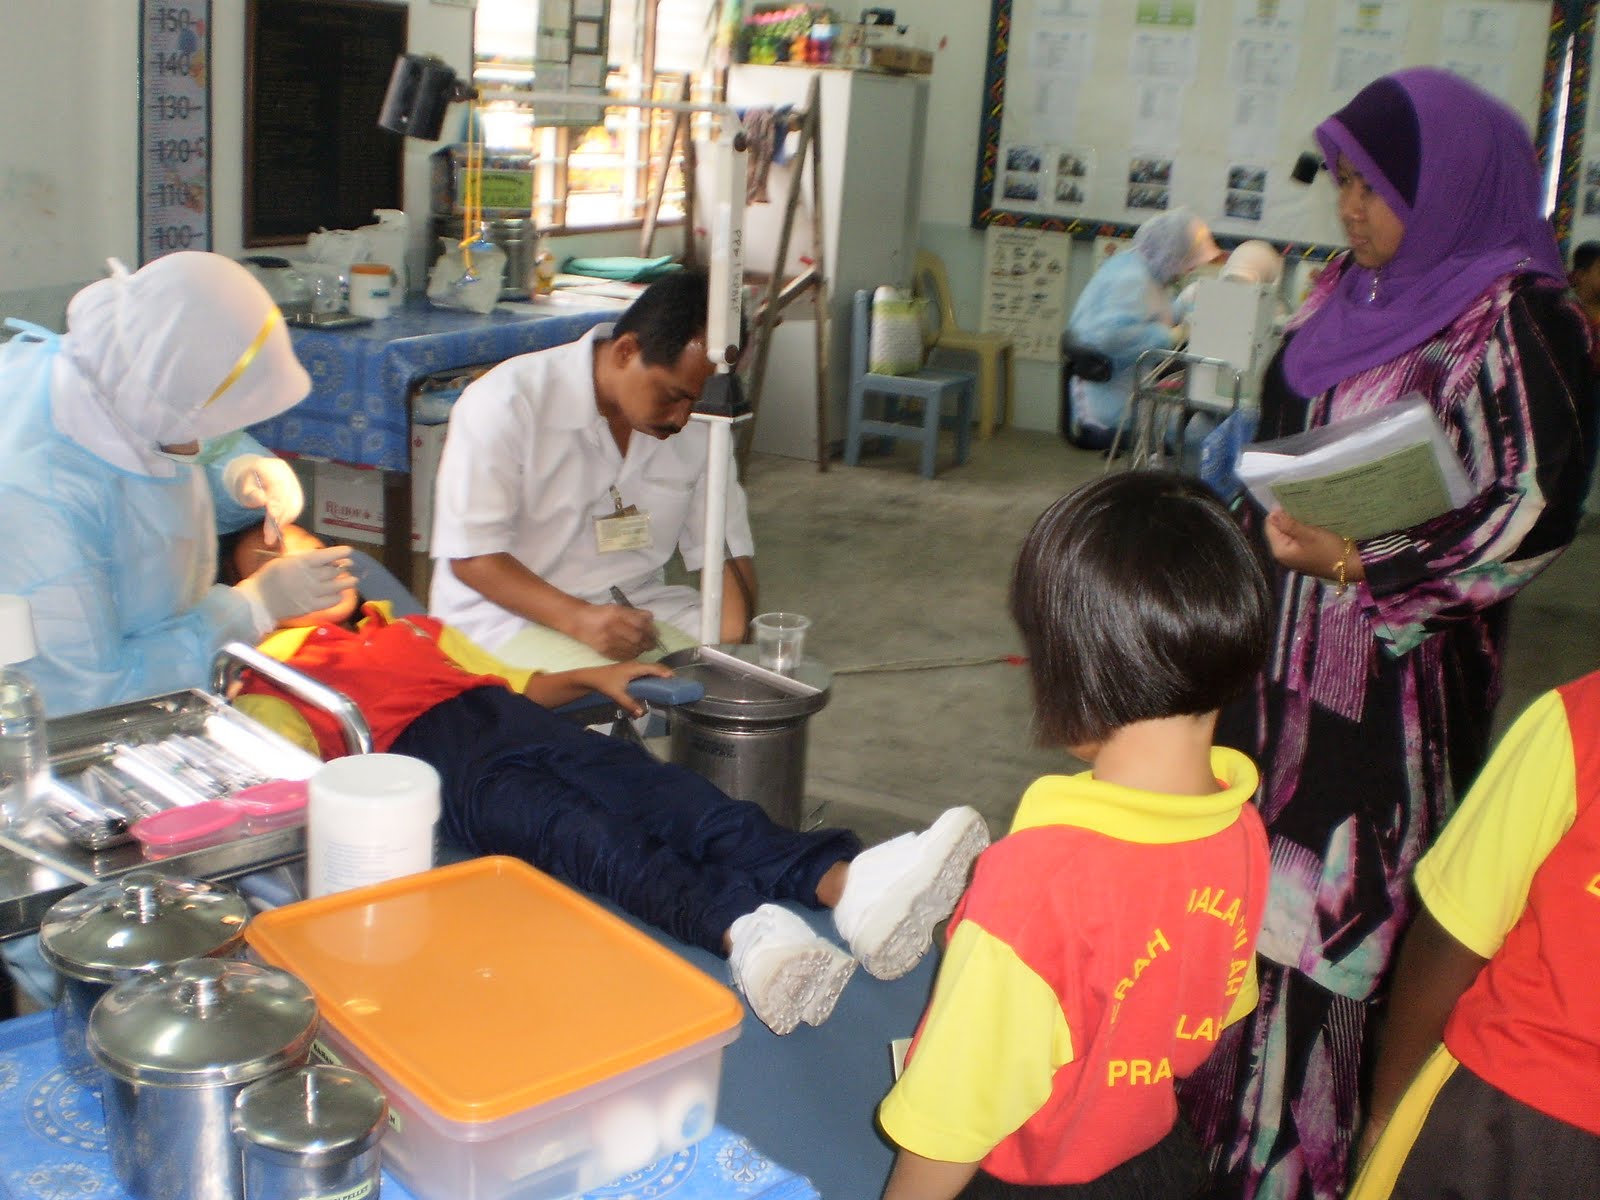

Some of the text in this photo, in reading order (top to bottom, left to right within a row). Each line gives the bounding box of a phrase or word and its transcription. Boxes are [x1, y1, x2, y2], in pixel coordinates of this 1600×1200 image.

[157, 8, 190, 32] 150
[157, 52, 190, 76] 140
[157, 95, 190, 119] 130
[157, 139, 190, 163] 120
[157, 225, 191, 250] 100
[1107, 1056, 1173, 1087] PRA
